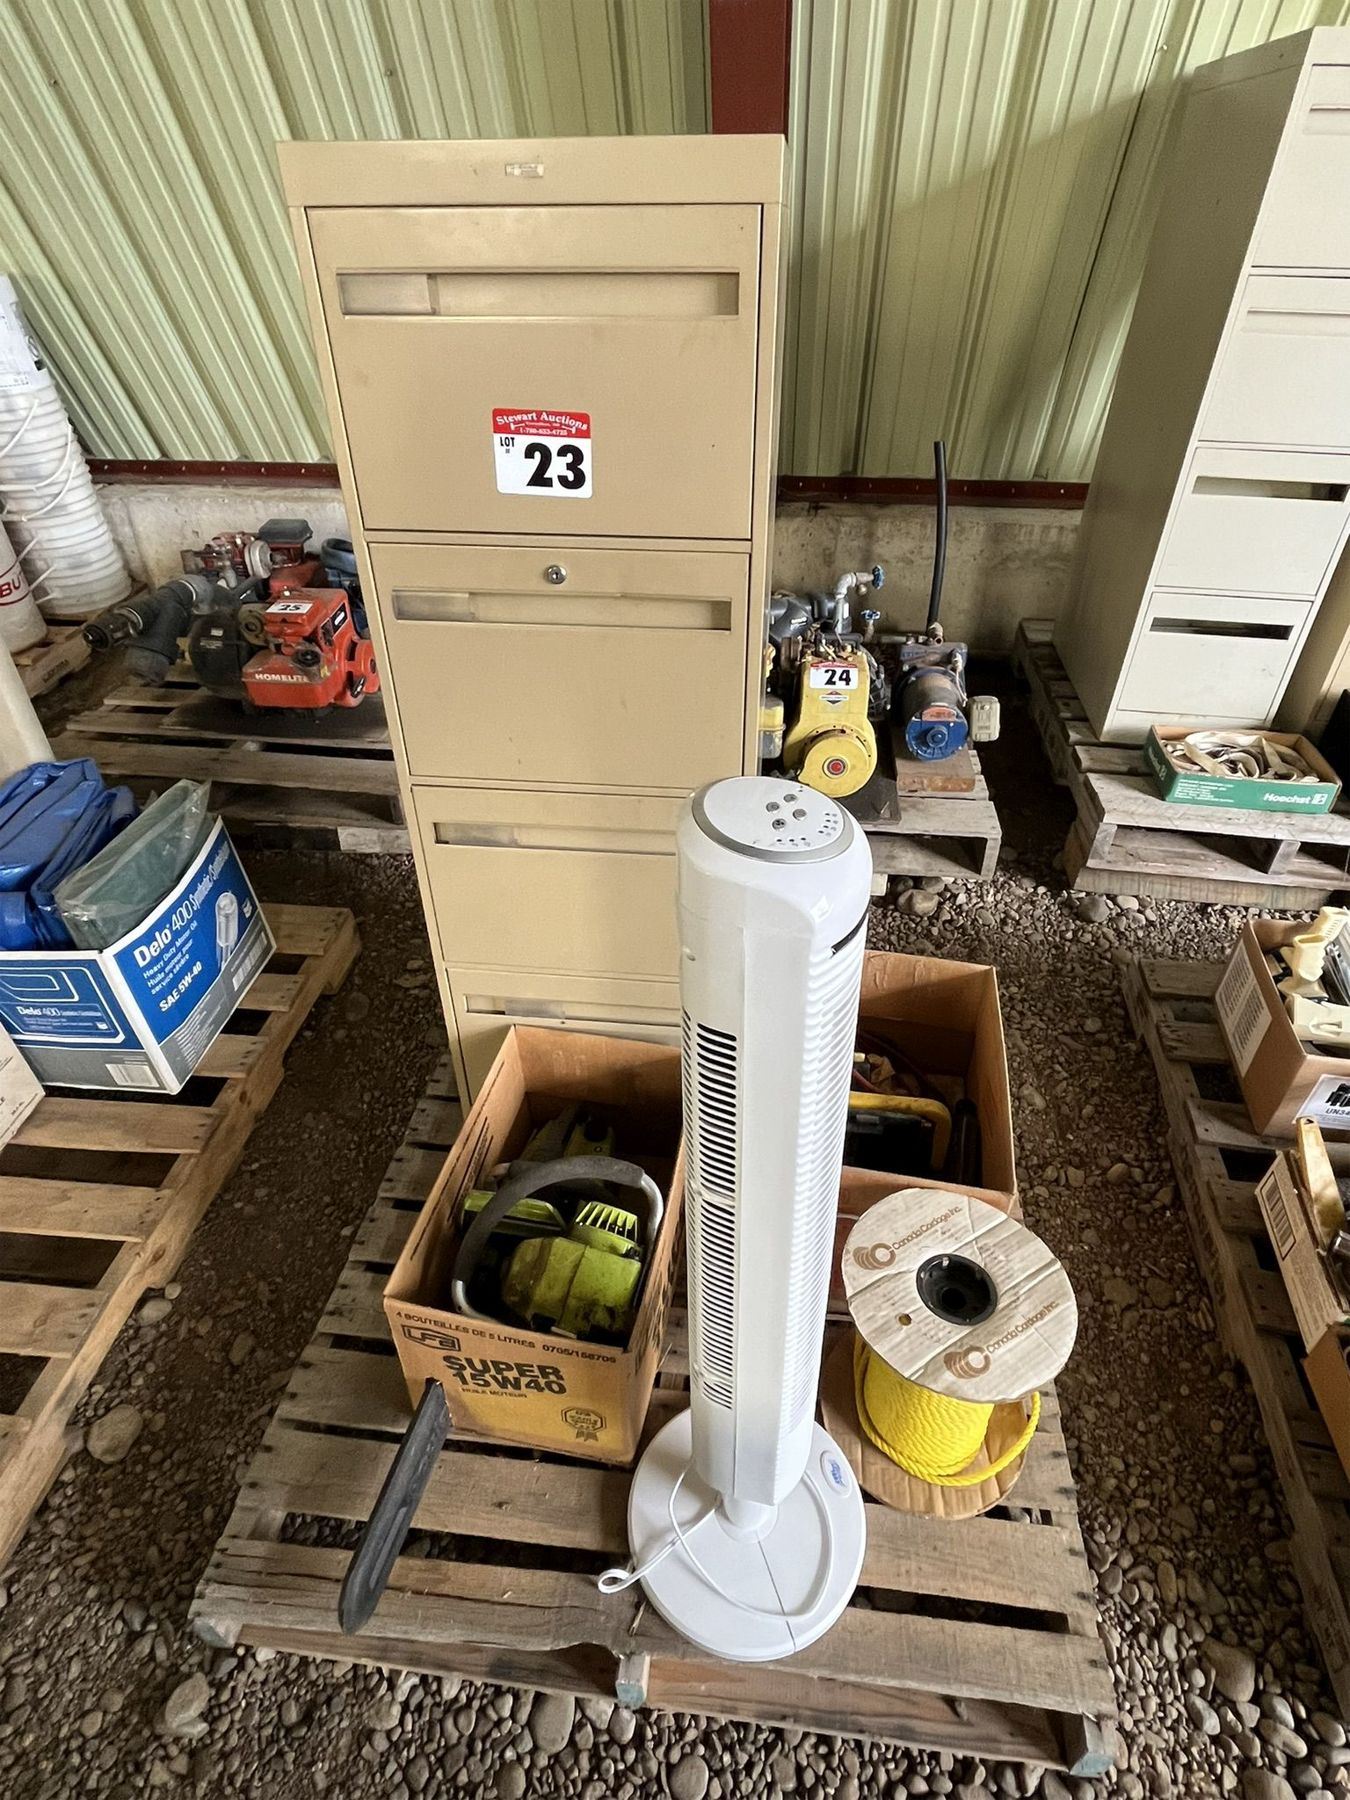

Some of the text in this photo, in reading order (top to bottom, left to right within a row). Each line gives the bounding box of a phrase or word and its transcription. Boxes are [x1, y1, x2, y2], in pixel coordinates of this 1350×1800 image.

[496, 412, 588, 430] Stewart Auctions
[500, 437, 515, 447] LOT
[524, 442, 586, 490] 23
[824, 669, 852, 686] 24
[1263, 792, 1312, 804] Hoechst
[133, 929, 171, 968] Delo
[171, 901, 194, 931] 400
[143, 960, 164, 979] Heavy
[163, 945, 177, 962] Duty
[175, 931, 191, 948] Motor
[159, 987, 180, 1012] SAE
[177, 960, 203, 993] 5W-40
[16, 1006, 41, 1016] Delo
[893, 1205, 963, 1250] Canada Cordage Inc.
[404, 1314, 469, 1334] BOUTEILLES
[471, 1329, 486, 1337] DE
[497, 1335, 535, 1349] LITRES
[986, 1300, 1060, 1354] Canada Cordage Inc.
[442, 1354, 566, 1381] SUPER
[452, 1373, 567, 1395] 15W40
